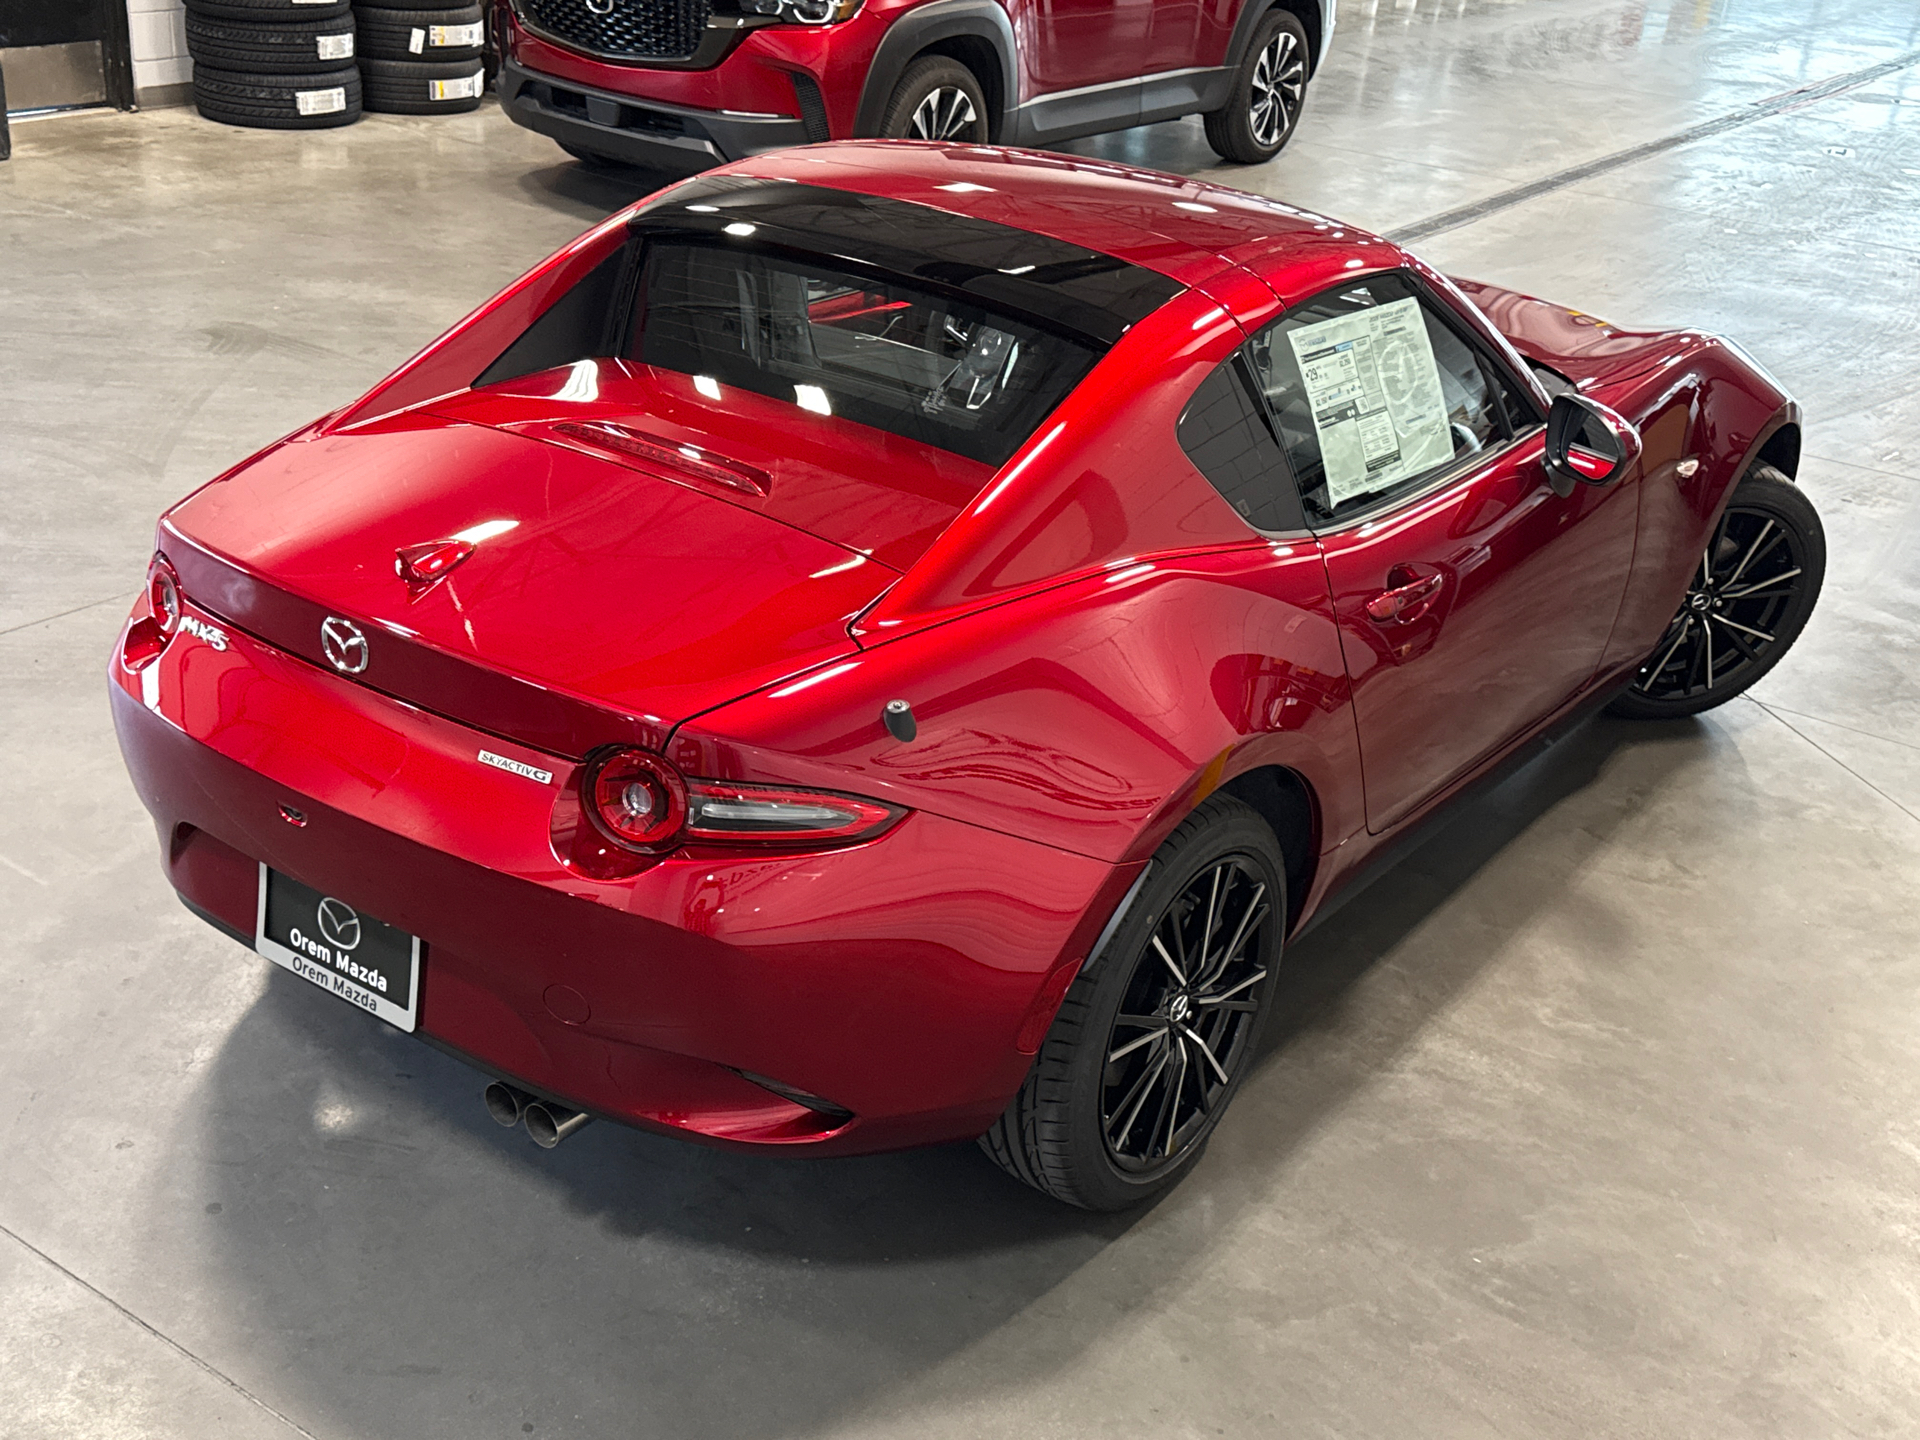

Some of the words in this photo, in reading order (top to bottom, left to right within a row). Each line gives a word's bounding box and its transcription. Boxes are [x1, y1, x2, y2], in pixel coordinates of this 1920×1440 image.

[290, 928, 331, 963] Orem
[335, 951, 387, 992] Mazda
[292, 956, 329, 986] Orem
[333, 976, 377, 1012] Mazda
